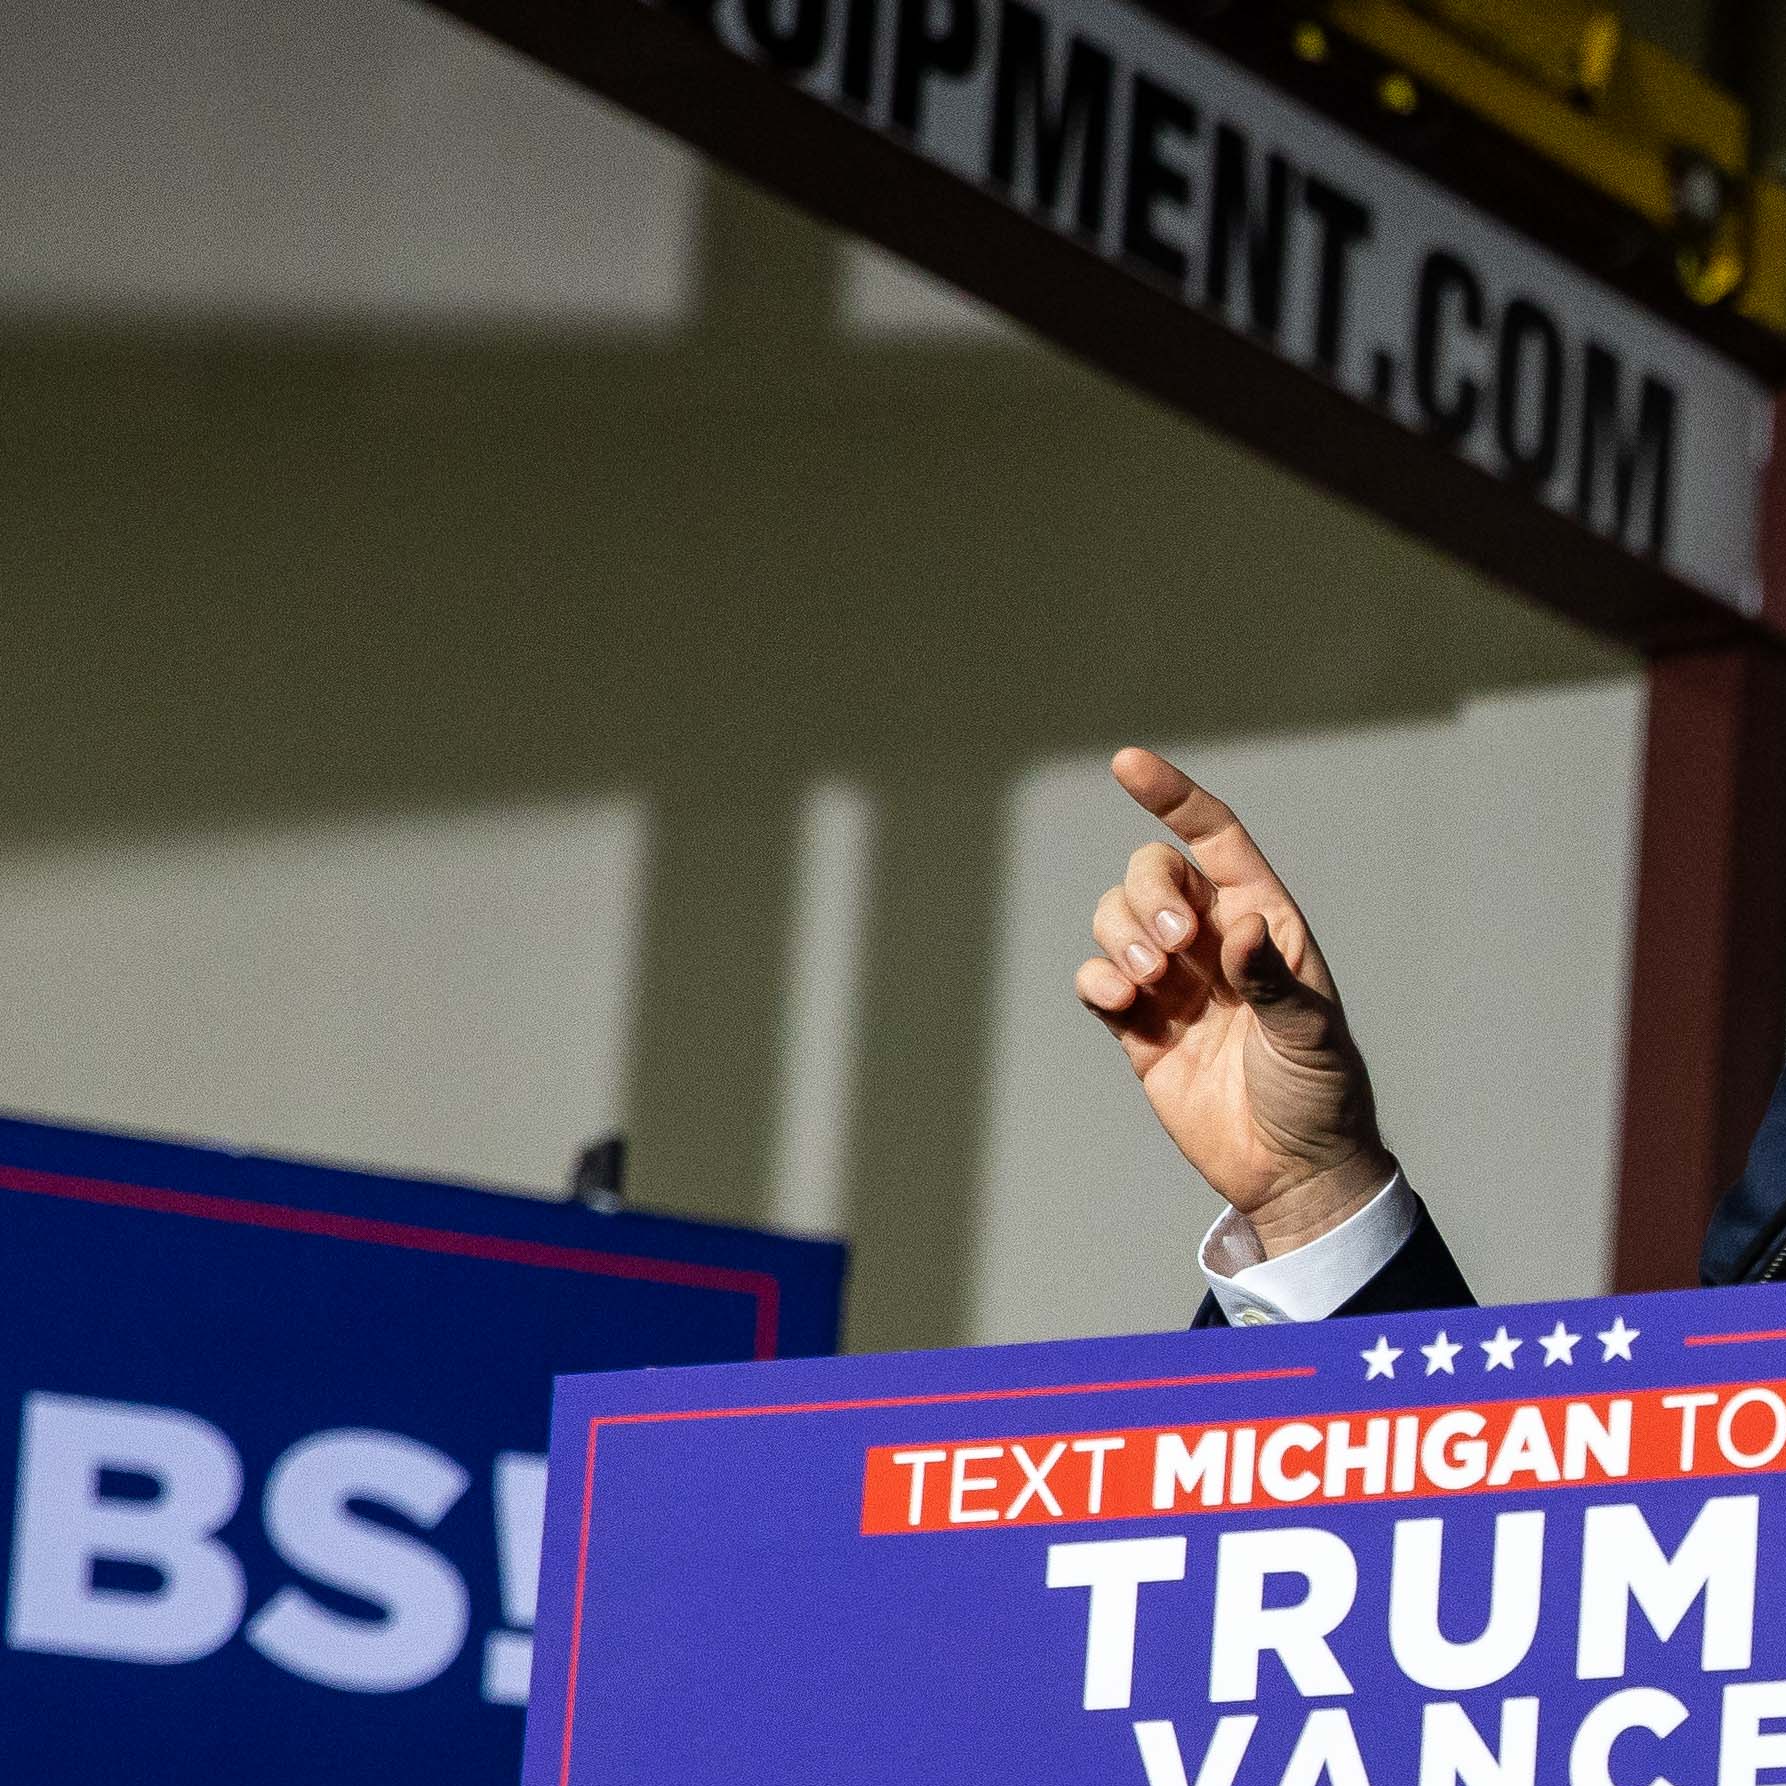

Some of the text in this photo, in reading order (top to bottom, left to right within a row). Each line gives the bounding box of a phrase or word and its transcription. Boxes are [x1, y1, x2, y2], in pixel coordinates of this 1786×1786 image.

[6, 1388, 549, 1706] BS!
[892, 1436, 1126, 1527] TEXT
[1151, 1398, 1634, 1511] MICHIGAN
